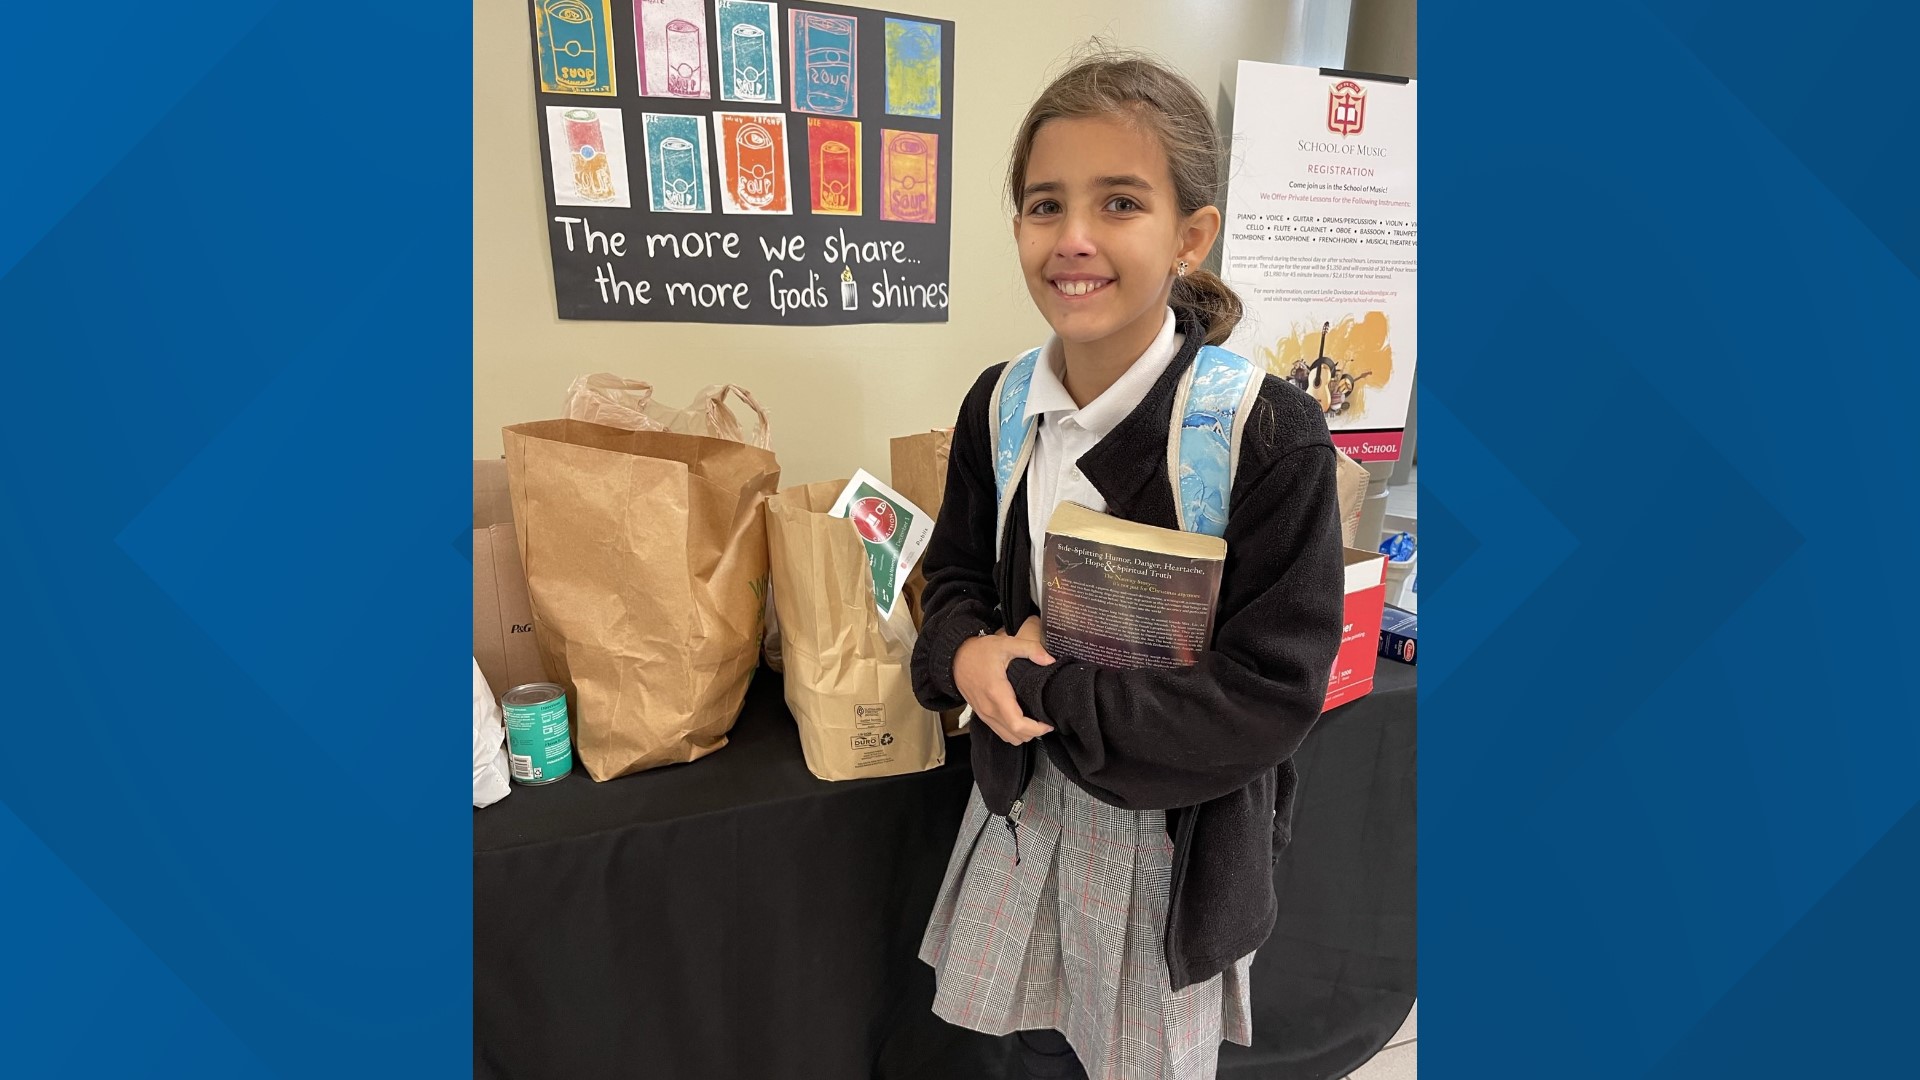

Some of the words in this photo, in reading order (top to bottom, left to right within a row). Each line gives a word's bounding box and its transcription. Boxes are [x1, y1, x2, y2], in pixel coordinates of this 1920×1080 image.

[669, 74, 696, 91] SOUP
[736, 79, 762, 96] SOUP
[1307, 164, 1375, 177] REGISTRATION
[740, 176, 771, 196] SOUP
[1289, 181, 1306, 189] Come
[1307, 182, 1318, 190] join
[1343, 184, 1362, 192] School
[666, 189, 692, 205] SOUP
[892, 191, 926, 210] SOUP
[1271, 193, 1287, 201] Offer
[1288, 194, 1309, 202] Private
[1310, 194, 1332, 202] Lessons
[1352, 197, 1378, 206] Following
[1379, 198, 1411, 207] Instruments:
[1322, 217, 1377, 225] DRUMS/PERCUSSION
[555, 216, 627, 257] The
[646, 231, 740, 258] more
[759, 235, 805, 261] we
[824, 227, 921, 263] share...
[1365, 238, 1388, 246] MUSICAL
[594, 262, 652, 304] the
[665, 282, 751, 309] more
[769, 268, 828, 316] God's
[872, 268, 949, 308] shines
[915, 528, 929, 545] Publix
[1058, 543, 1103, 560] Side-Splitting
[1105, 553, 1132, 564] Humor,
[1134, 558, 1162, 570] Danger,
[1164, 563, 1205, 575] Heartache,
[1085, 558, 1104, 568] Hope
[1104, 561, 1117, 573] &
[1117, 564, 1148, 575] Spiritual
[1150, 569, 1172, 579] Truth
[1149, 586, 1177, 596] Christmas
[511, 623, 532, 634] P&G
[854, 738, 877, 746] DURO
